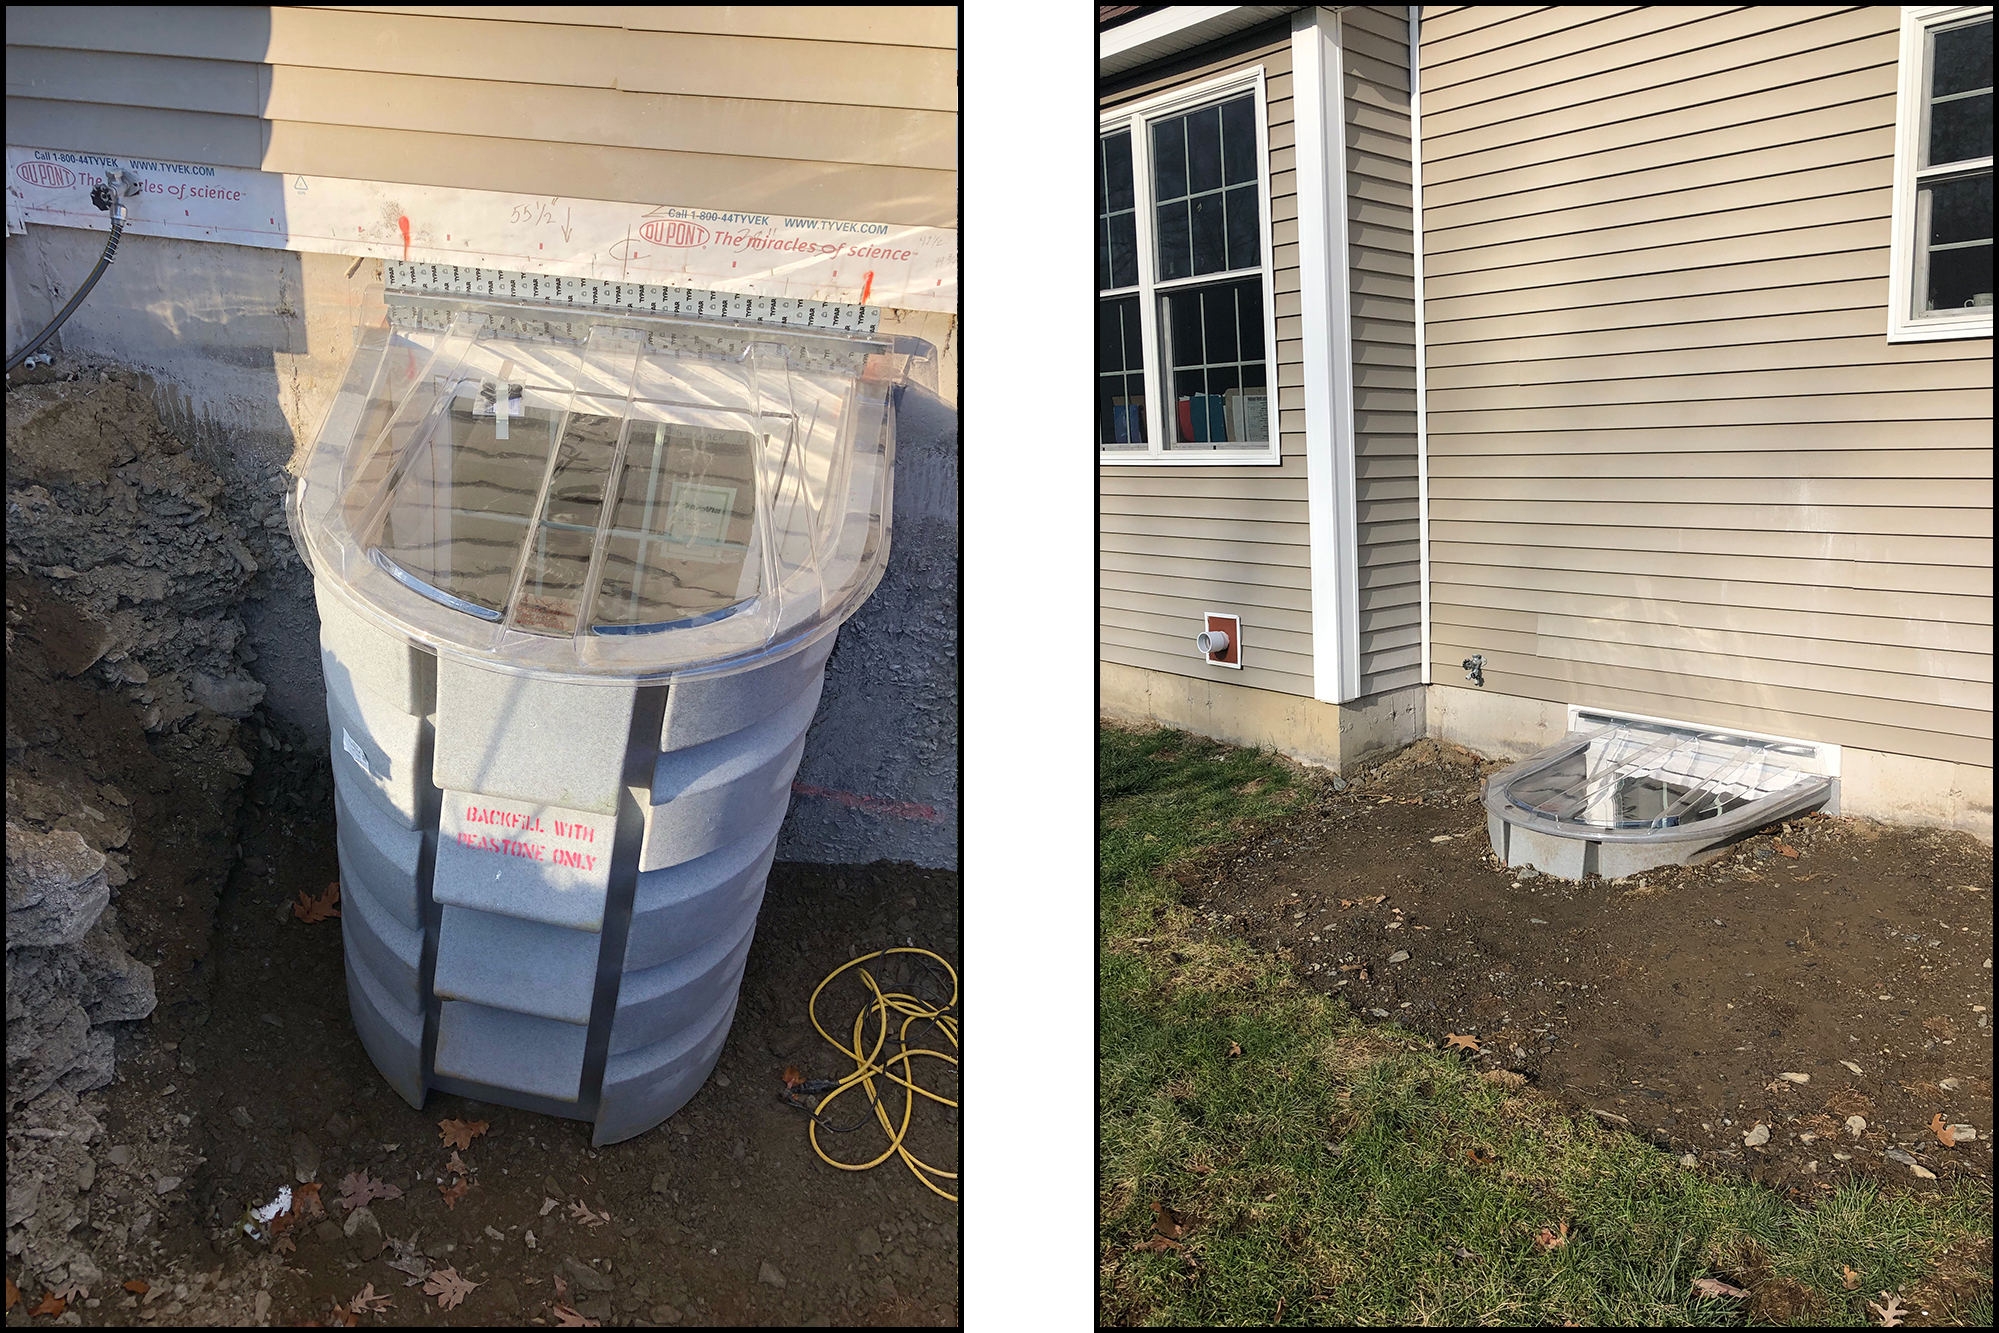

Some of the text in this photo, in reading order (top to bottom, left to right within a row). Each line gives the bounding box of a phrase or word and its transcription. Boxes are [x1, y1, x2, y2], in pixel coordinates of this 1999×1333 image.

[34, 150, 215, 177] Call 1-800-44TYVEK WWW.TYVEK.COM
[78, 172, 103, 186] The
[167, 184, 187, 200] of
[668, 208, 889, 235] Call 1-800-44TYVEK WWW.TYVEK.COM
[714, 231, 743, 247] The
[747, 235, 817, 253] miracles
[821, 242, 847, 260] of
[466, 806, 595, 843] BACKFILL WITH
[457, 832, 597, 871] PEASTONE ONLY
